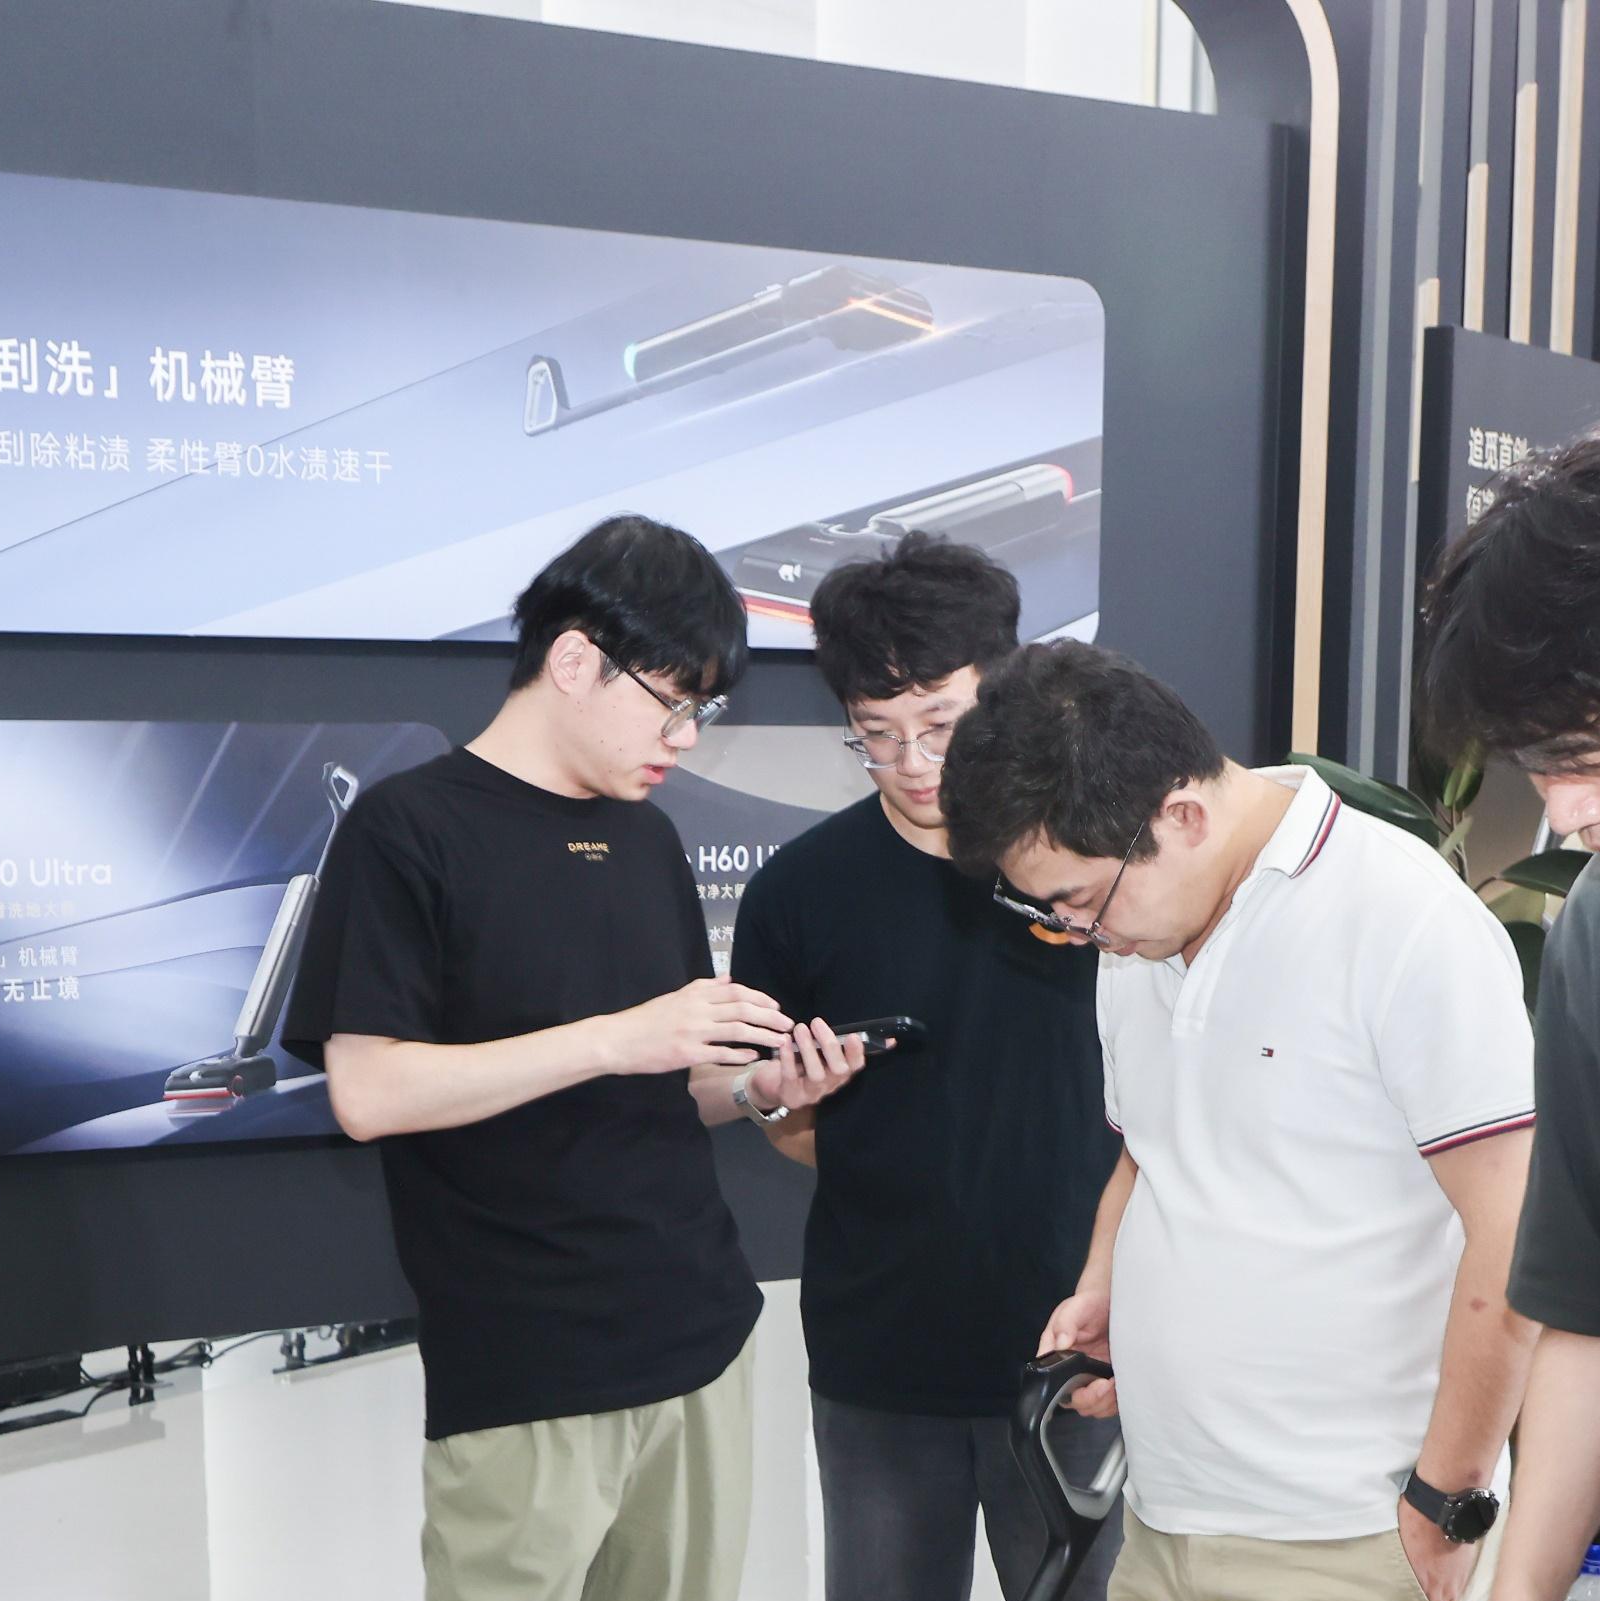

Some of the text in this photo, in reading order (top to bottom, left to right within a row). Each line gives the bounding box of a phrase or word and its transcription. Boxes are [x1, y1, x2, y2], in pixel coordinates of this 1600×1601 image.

[146, 437, 393, 485] 柔性臂0水渍速干
[29, 858, 112, 886] Ultra
[698, 845, 750, 873] H60
